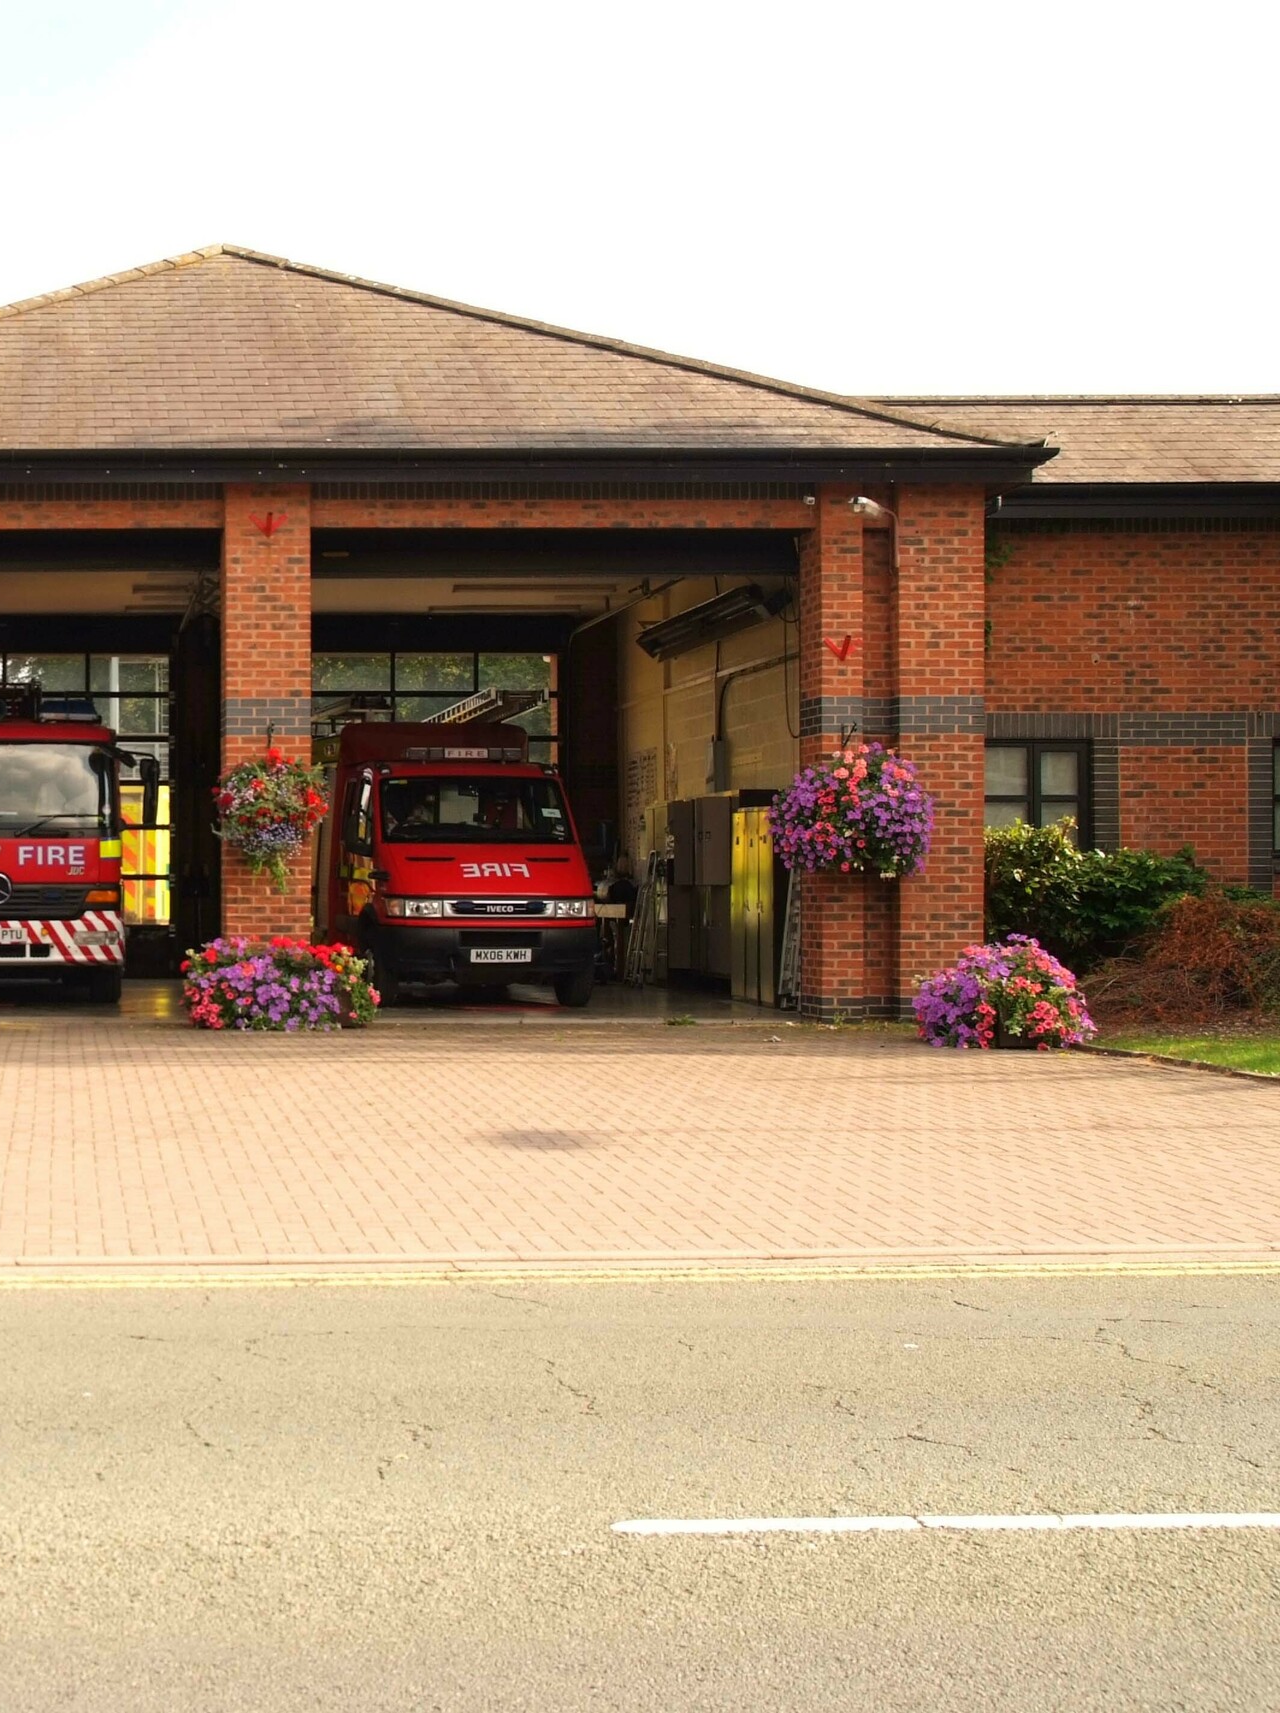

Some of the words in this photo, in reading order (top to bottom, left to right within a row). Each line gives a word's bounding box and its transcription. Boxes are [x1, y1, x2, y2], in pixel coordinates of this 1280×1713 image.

[18, 846, 85, 865] FIRE
[486, 905, 514, 913] IVECO
[1, 930, 23, 940] PTU
[475, 950, 503, 961] MX06
[506, 950, 527, 961] KWH
